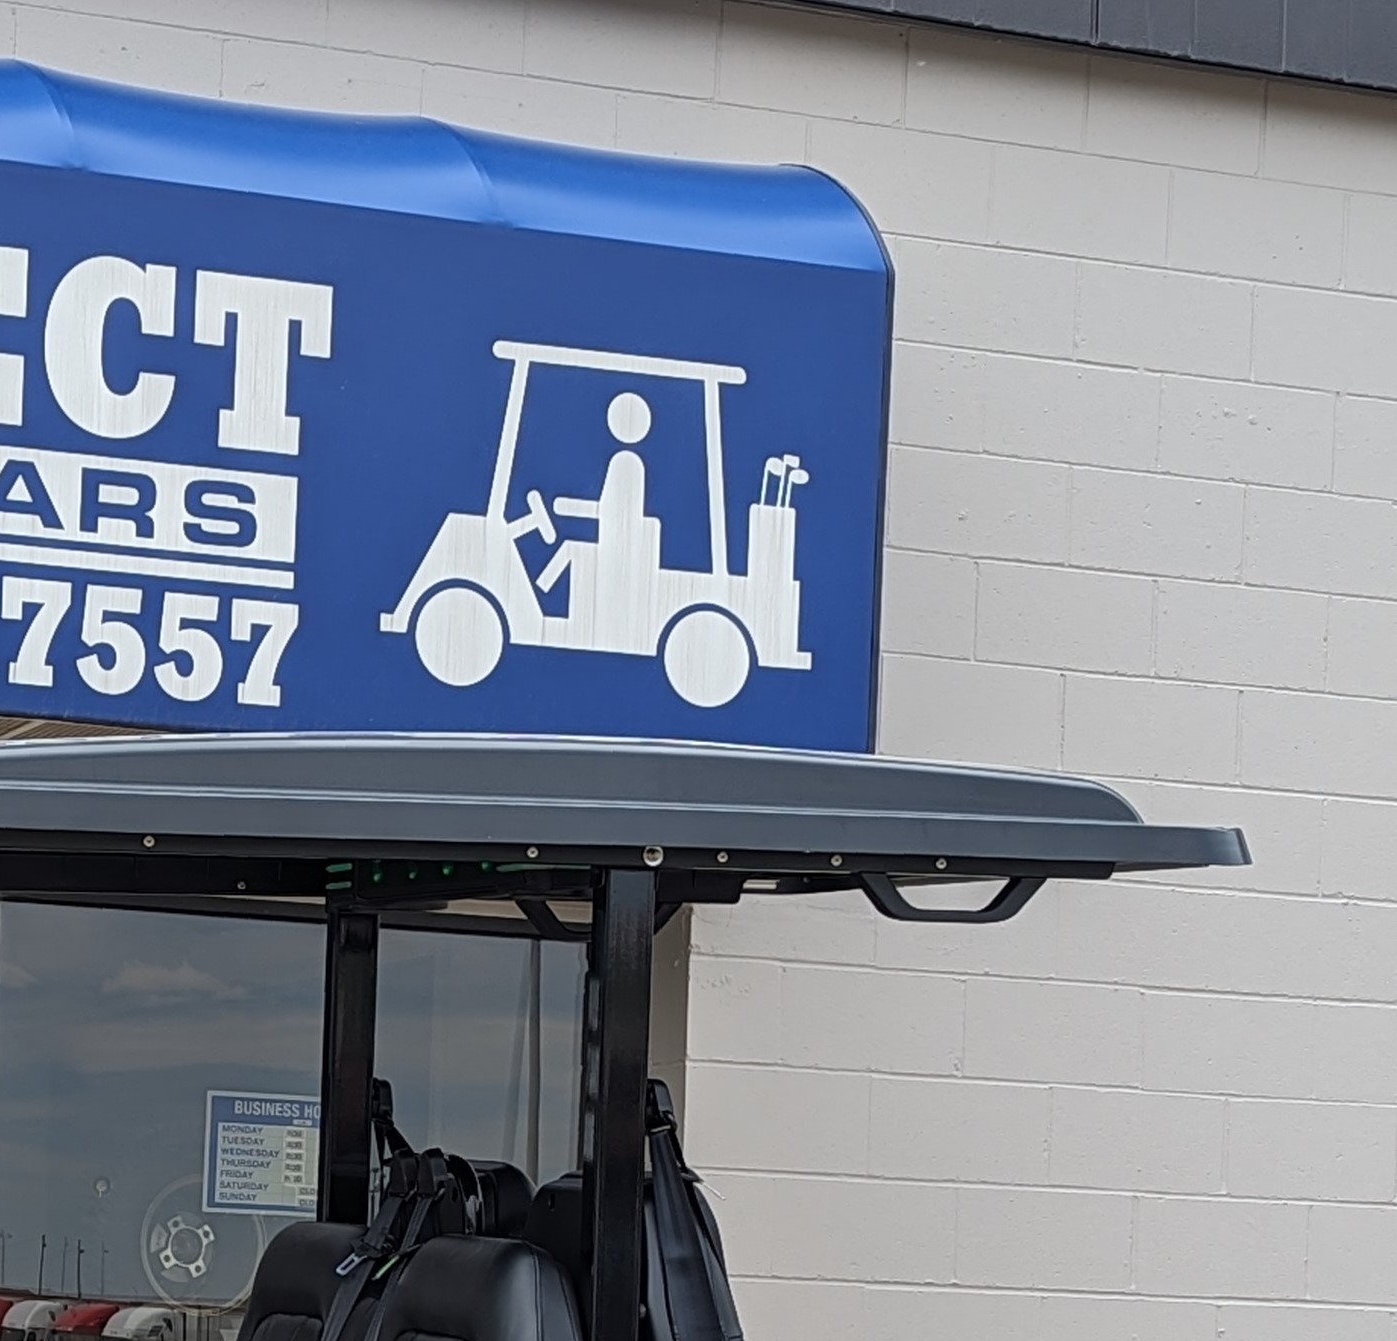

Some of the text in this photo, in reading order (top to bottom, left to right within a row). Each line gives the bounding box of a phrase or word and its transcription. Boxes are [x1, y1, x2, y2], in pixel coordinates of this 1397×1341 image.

[235, 1101, 300, 1117] BUSINESS
[222, 1125, 264, 1135] MONDAY
[221, 1136, 265, 1146] TUESDAY
[221, 1148, 281, 1158] WEDNESDAY
[221, 1159, 272, 1168] THURSDAY
[219, 1169, 255, 1179] FRIDAY
[218, 1180, 270, 1190] SATURDAY
[218, 1191, 258, 1201] SUNDAY
